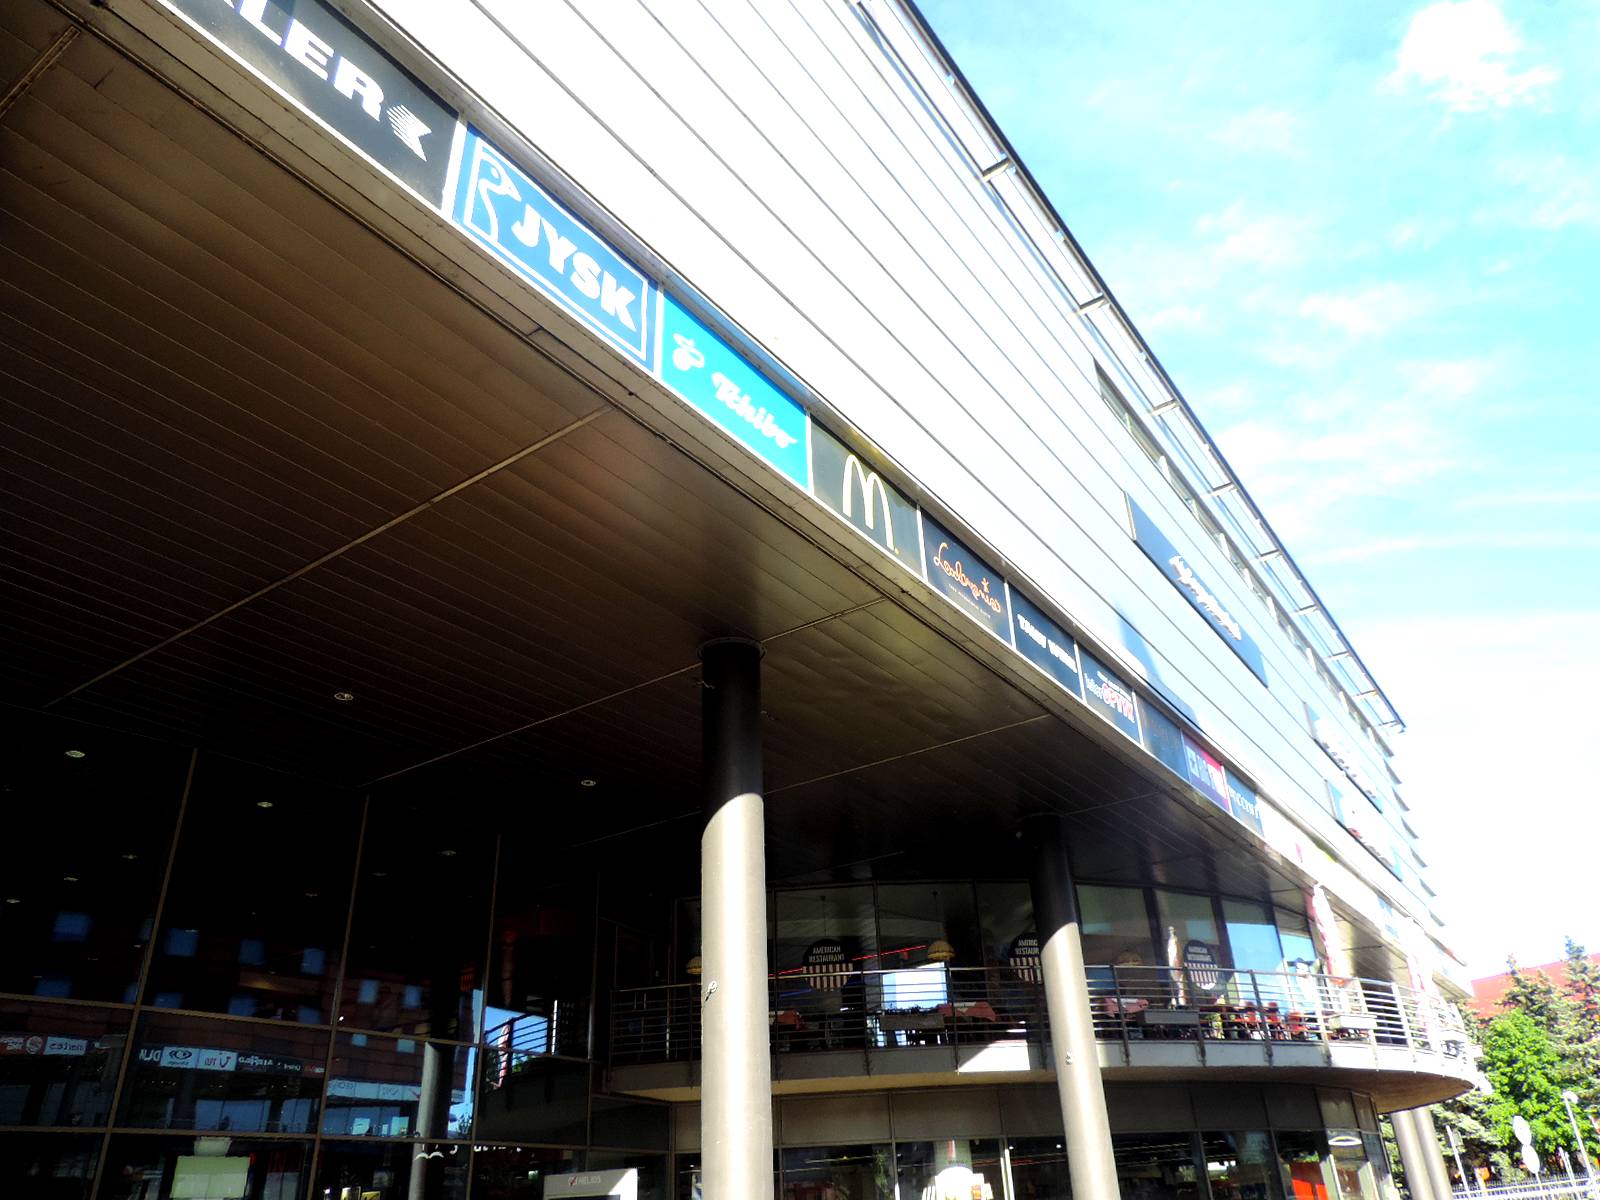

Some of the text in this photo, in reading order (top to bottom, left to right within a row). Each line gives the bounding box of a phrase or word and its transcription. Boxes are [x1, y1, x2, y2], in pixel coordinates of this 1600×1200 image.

[223, 0, 384, 122] LER
[511, 203, 637, 332] JYSK
[711, 371, 798, 449] Tchibo
